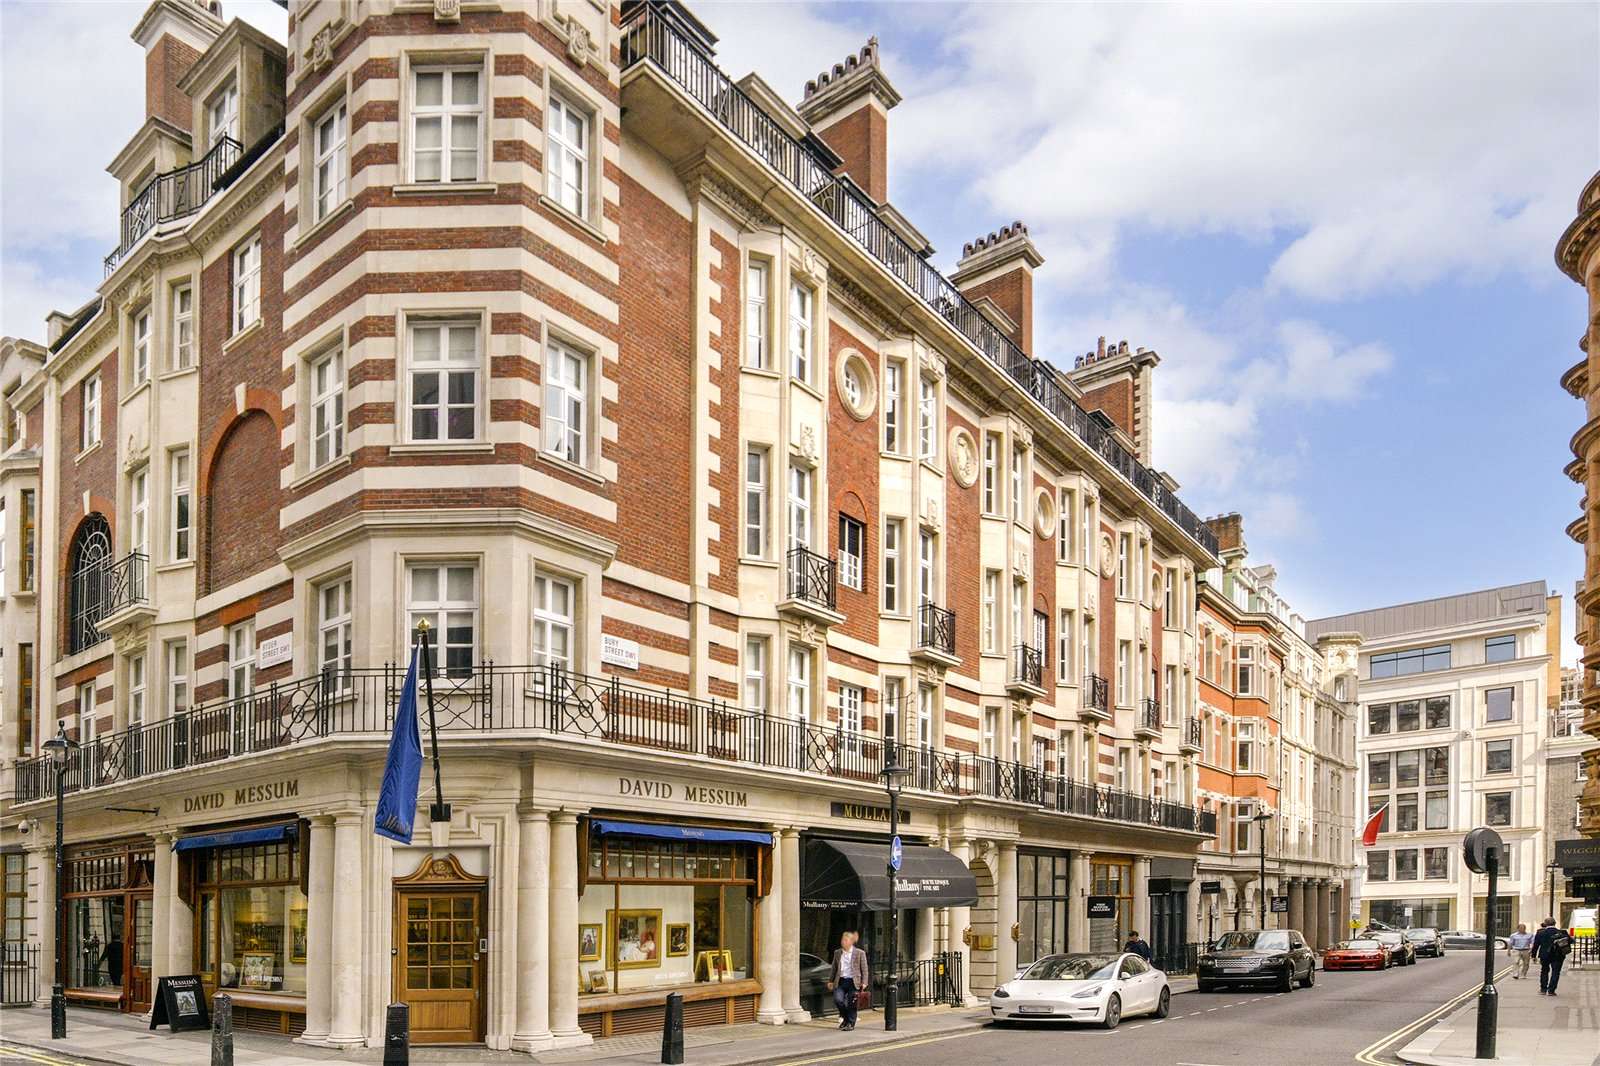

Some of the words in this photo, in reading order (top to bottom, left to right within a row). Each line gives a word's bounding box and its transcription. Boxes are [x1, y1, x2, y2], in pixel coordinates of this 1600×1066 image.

[604, 636, 619, 648] BURY
[262, 647, 279, 660] STREET
[279, 644, 290, 656] SW1
[604, 646, 624, 657] STREET
[183, 792, 225, 813] DAVID
[234, 779, 299, 806] MESSUM
[618, 777, 673, 799] DAVID
[684, 785, 748, 808] MESSUM
[843, 803, 904, 823] MULLAY
